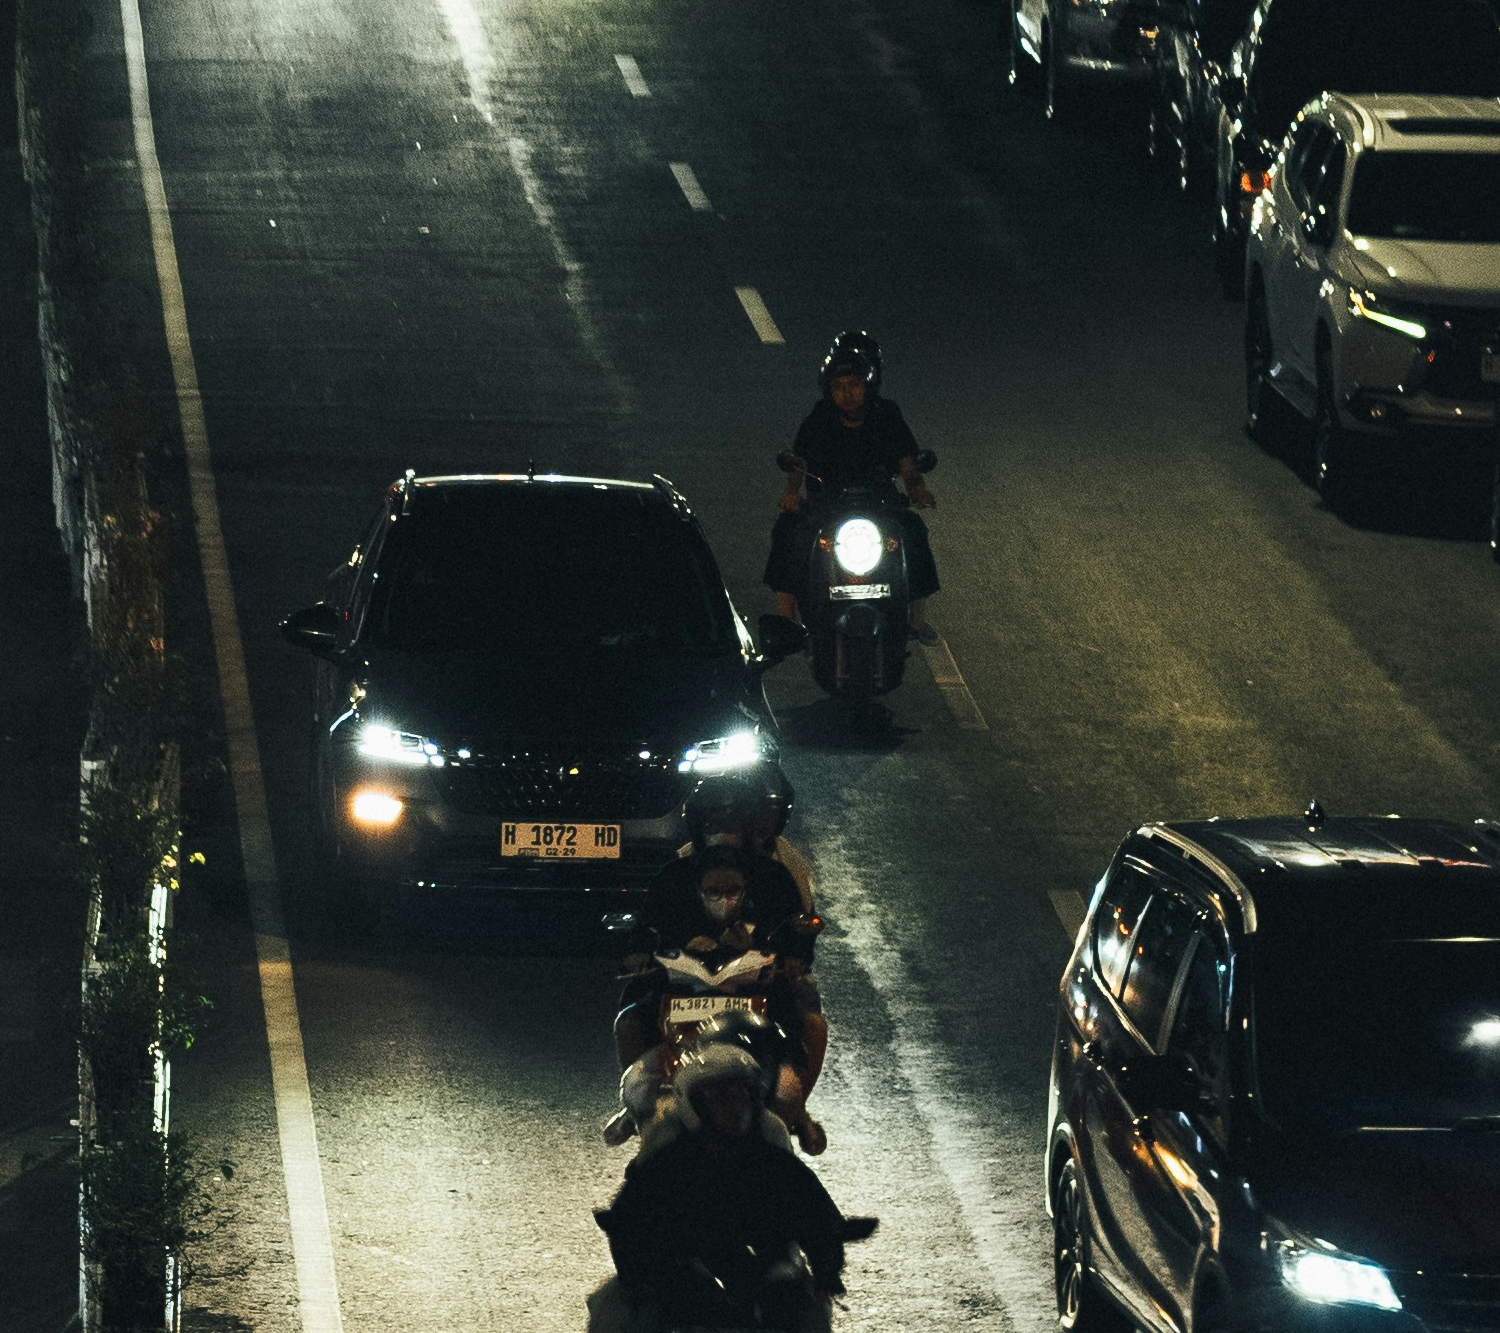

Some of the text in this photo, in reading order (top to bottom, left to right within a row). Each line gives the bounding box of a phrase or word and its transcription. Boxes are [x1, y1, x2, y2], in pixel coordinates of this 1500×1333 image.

[503, 824, 618, 847] H 1872 HD
